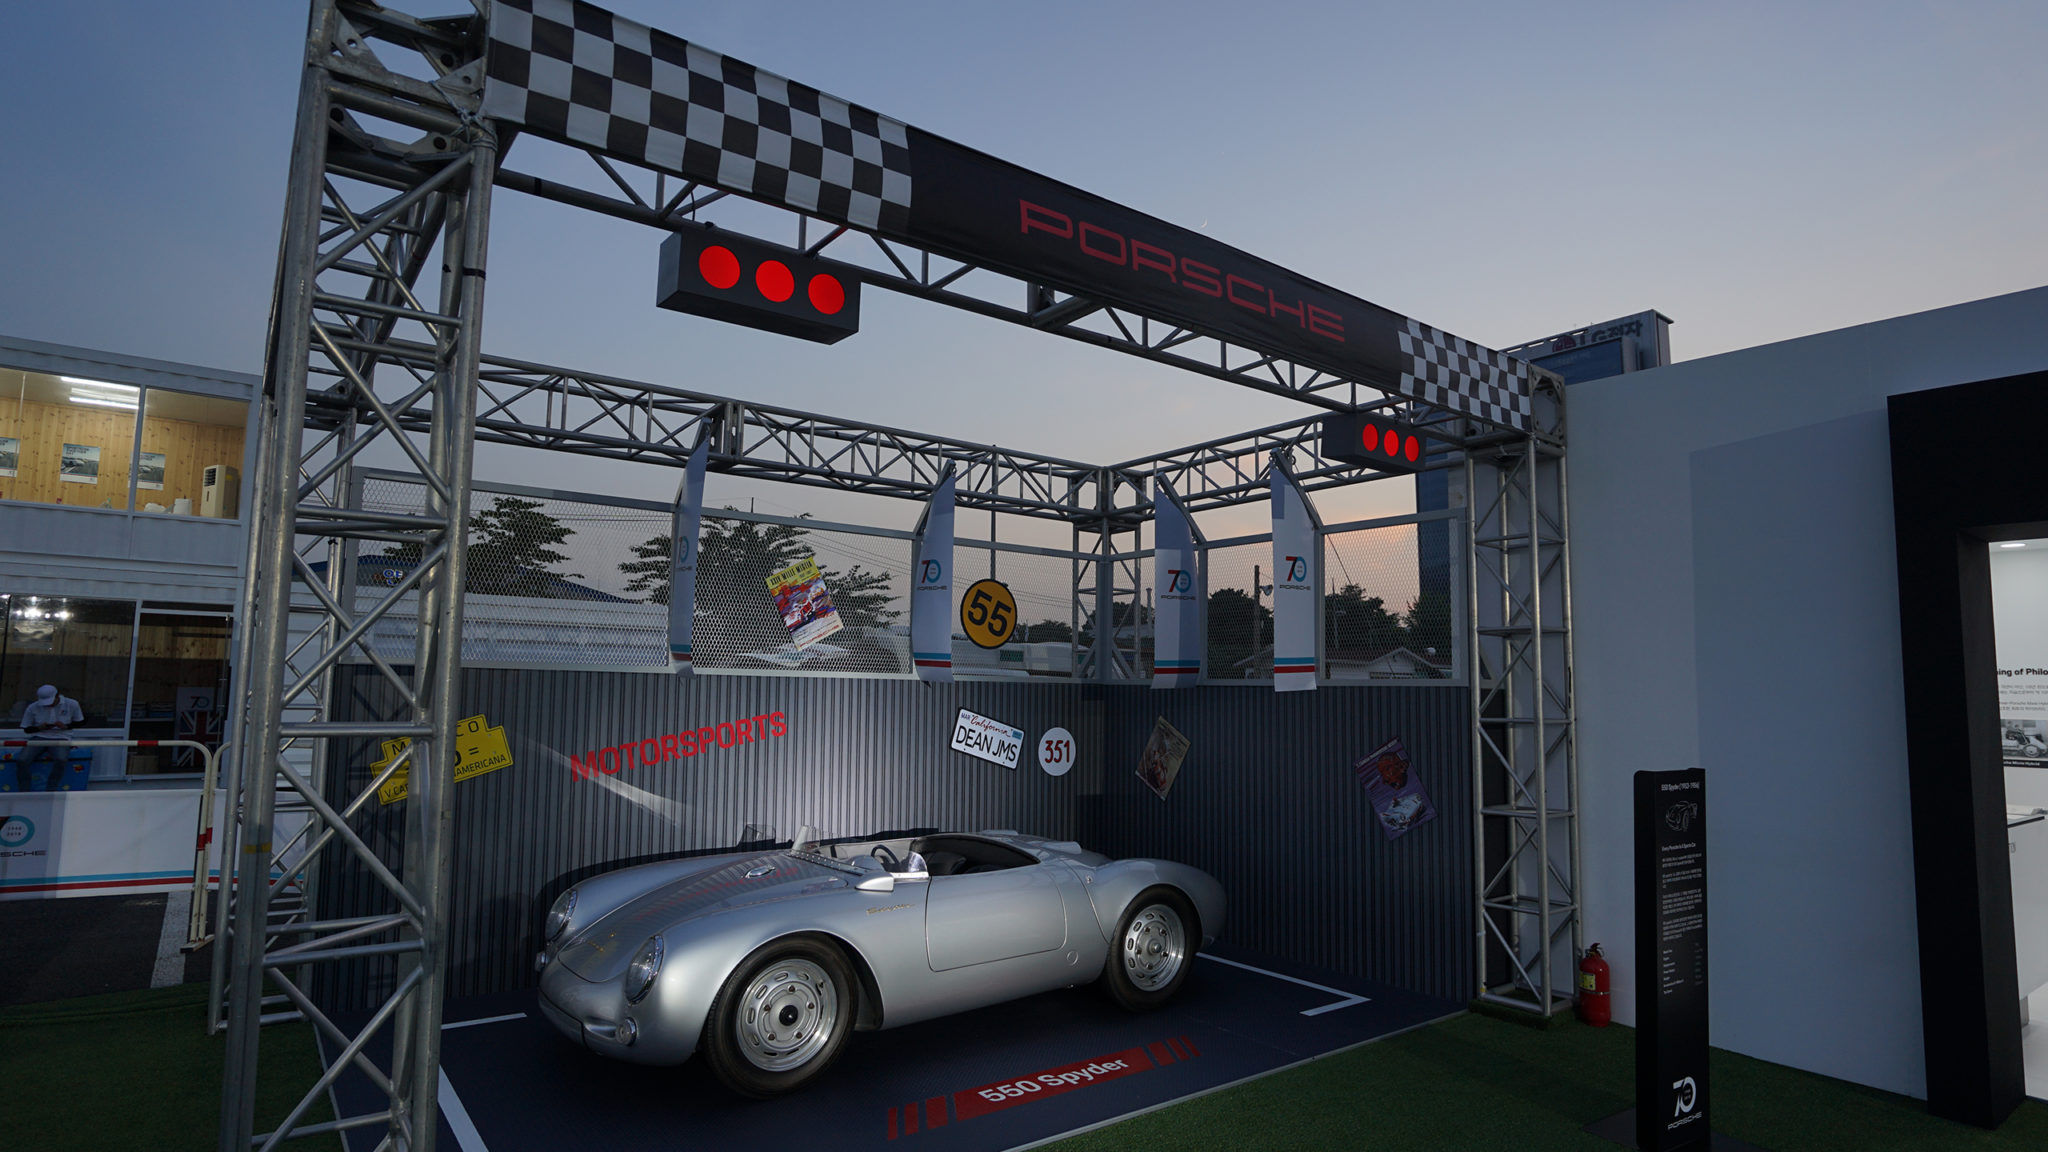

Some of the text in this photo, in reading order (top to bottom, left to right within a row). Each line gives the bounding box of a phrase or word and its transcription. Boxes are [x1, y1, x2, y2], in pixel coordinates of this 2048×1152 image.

[1019, 199, 1346, 343] PORSCHE
[781, 568, 796, 580] MILLE
[795, 560, 813, 573] MIGLIA
[921, 559, 941, 584] 70
[1168, 569, 1191, 593] 70
[1286, 556, 1307, 583] 70
[967, 589, 1012, 637] 55
[2014, 668, 2024, 676] of
[970, 715, 1011, 738] California
[570, 711, 787, 783] MOTORSPORTS
[956, 725, 1018, 762] DEAN JMS
[1045, 740, 1070, 764] 351
[455, 754, 507, 777] AMERICANA
[977, 1057, 1129, 1102] 550 Spyder
[1673, 1076, 1697, 1117] 70
